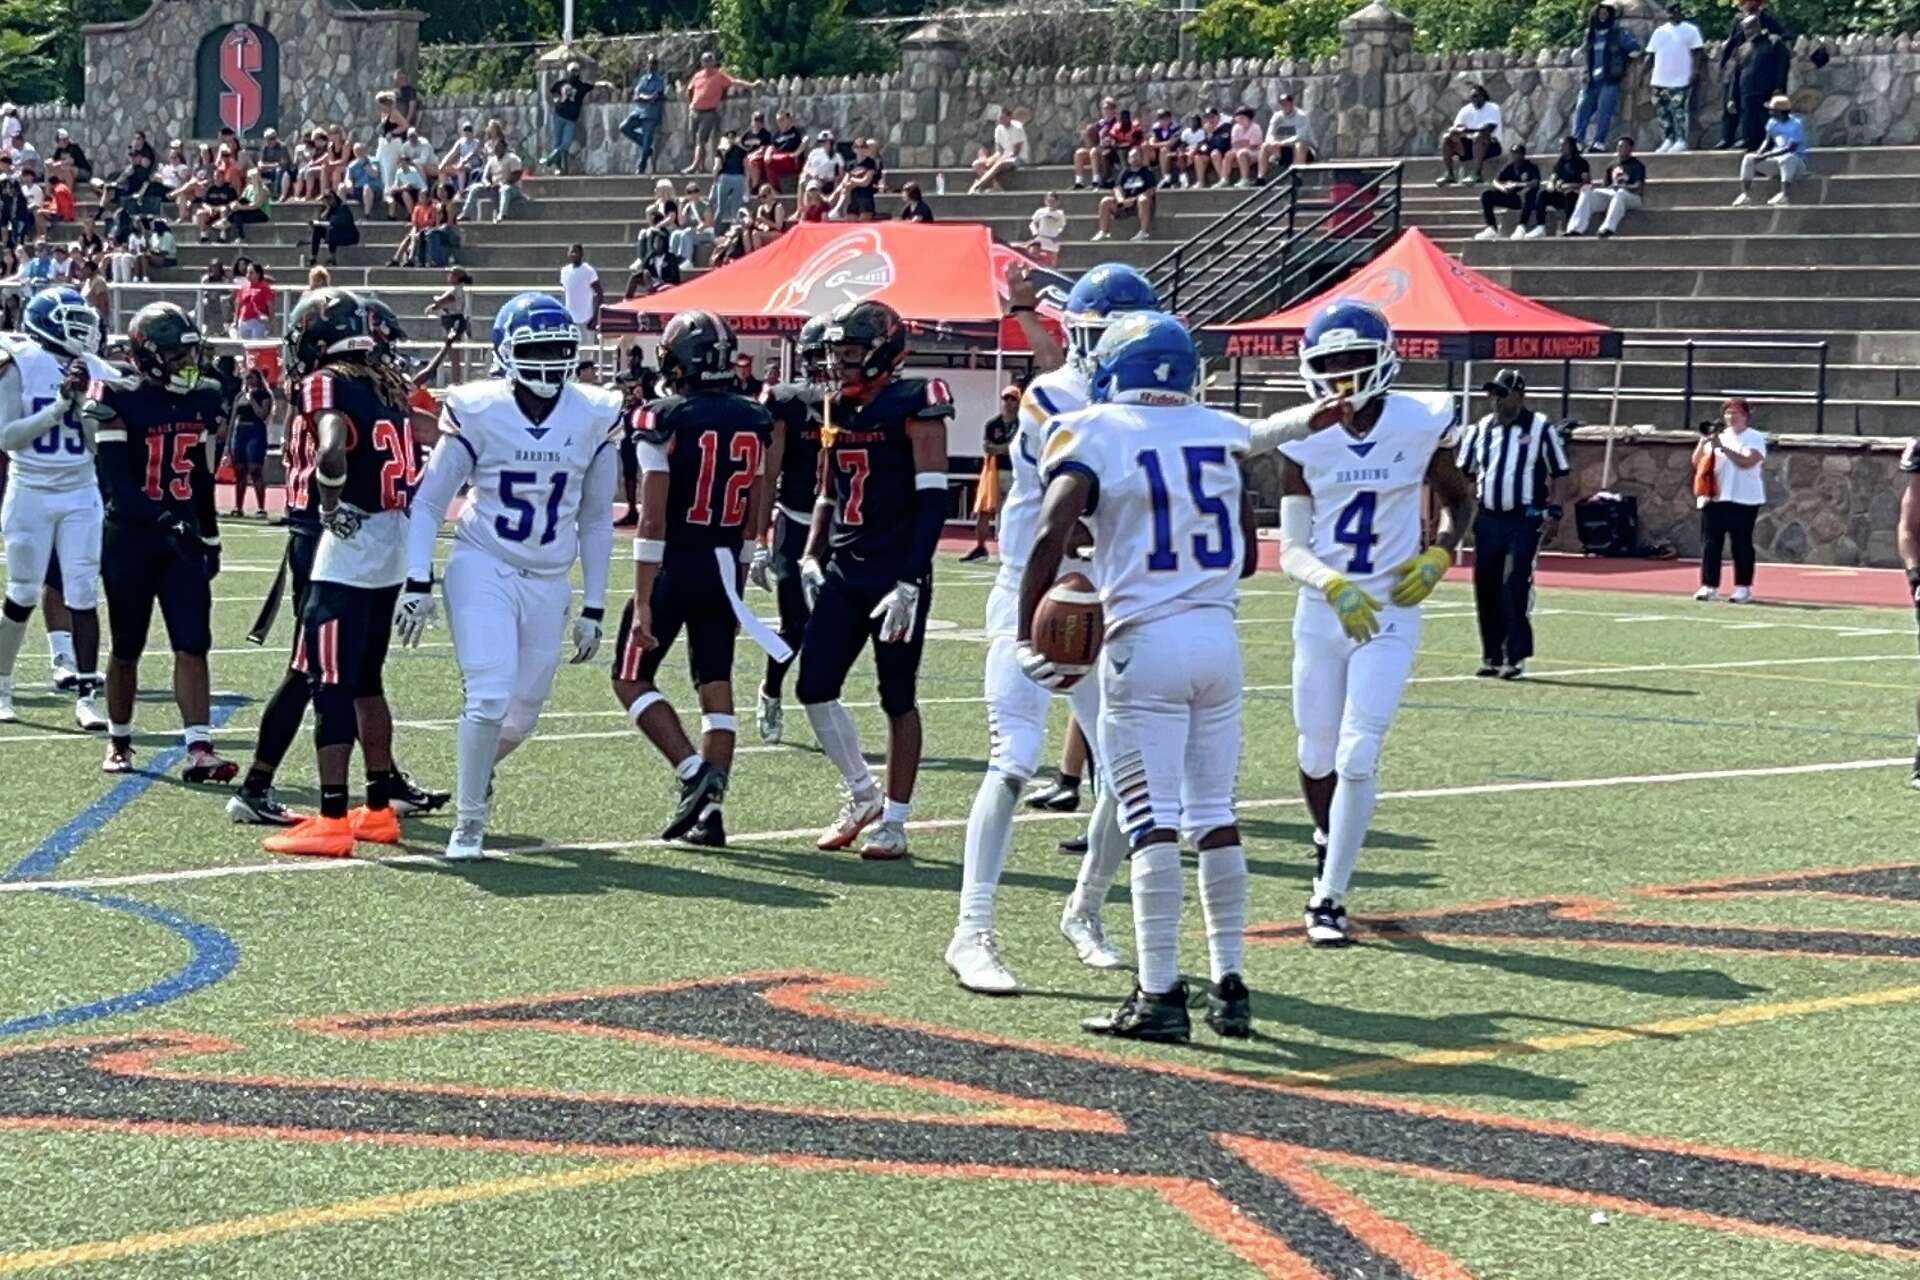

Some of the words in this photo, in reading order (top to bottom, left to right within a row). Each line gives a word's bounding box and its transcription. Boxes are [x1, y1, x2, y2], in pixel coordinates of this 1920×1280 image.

[219, 26, 263, 133] S
[1494, 336, 1538, 358] BLACK
[1541, 335, 1599, 357] KNIGHTS
[141, 432, 198, 501] 15
[686, 430, 760, 527] 12
[836, 449, 870, 526] 7
[494, 470, 569, 546] 51
[1136, 445, 1234, 572] 15
[1333, 490, 1380, 575] 4
